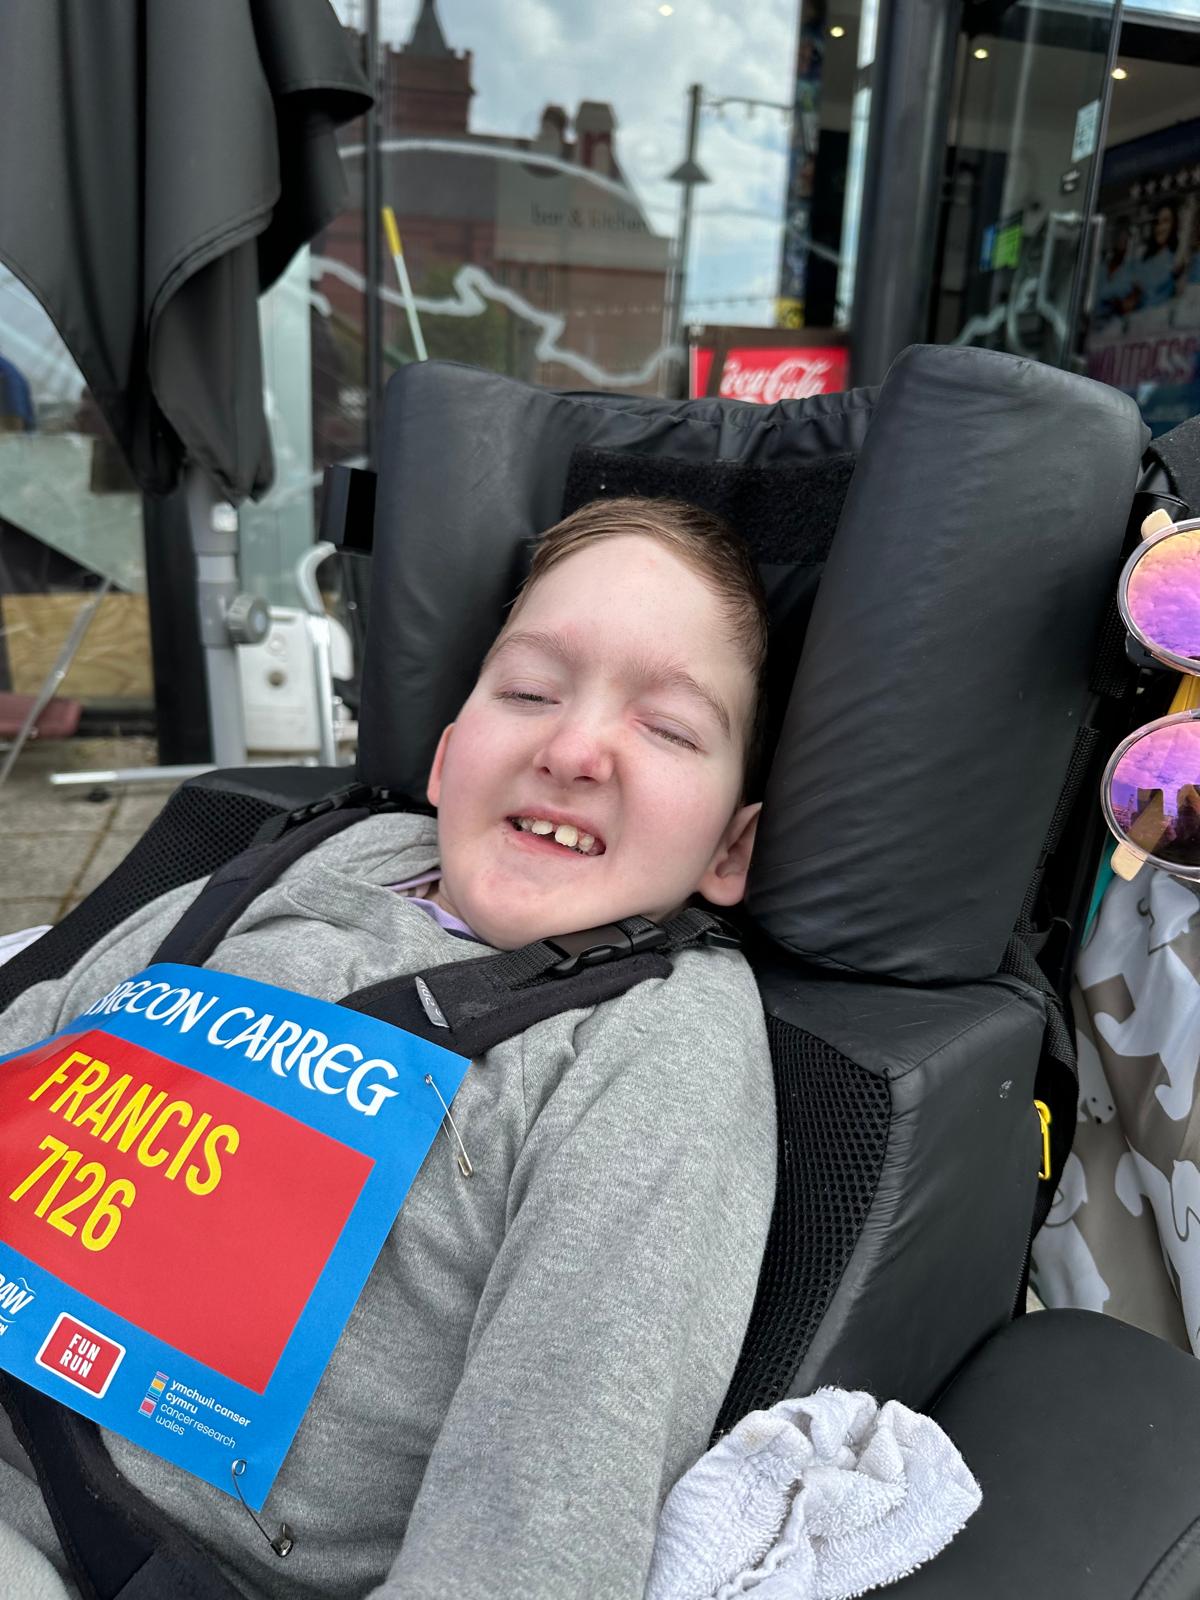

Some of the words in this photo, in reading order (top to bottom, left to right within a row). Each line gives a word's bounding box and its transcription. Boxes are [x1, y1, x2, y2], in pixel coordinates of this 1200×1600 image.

[207, 1006, 400, 1117] CARREG
[28, 1051, 240, 1195] FRANCIS
[9, 1134, 136, 1252] 7126
[59, 1349, 93, 1378] RUN
[69, 1333, 101, 1361] FUN
[155, 1415, 185, 1436] wales
[160, 1403, 195, 1426] cancer
[193, 1420, 236, 1448] research
[166, 1392, 198, 1414] cymru
[170, 1380, 215, 1409] ymchwil
[214, 1403, 251, 1427] canser
